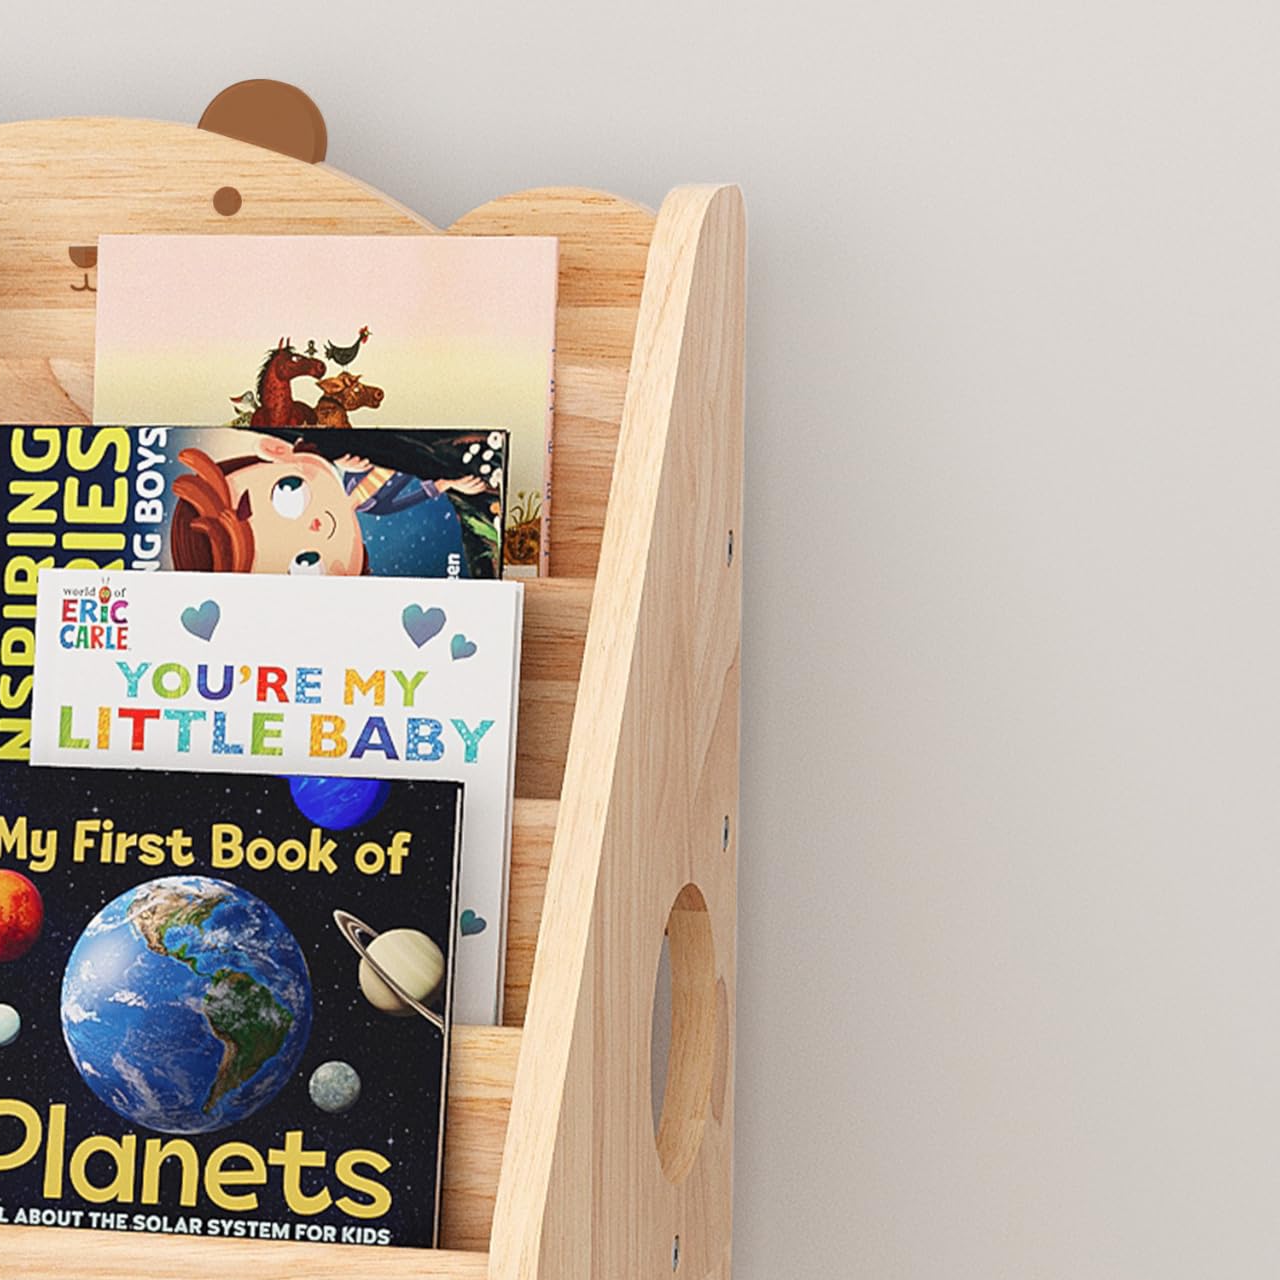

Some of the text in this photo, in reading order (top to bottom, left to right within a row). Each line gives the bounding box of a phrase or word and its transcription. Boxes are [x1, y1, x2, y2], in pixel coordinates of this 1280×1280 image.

[62, 427, 131, 569] IES
[134, 427, 168, 523] BOYS
[63, 587, 127, 598] world of
[59, 625, 128, 650] CARLE
[116, 661, 429, 707] YOU'RE MY
[58, 705, 496, 764] LITTLE BABY
[72, 818, 195, 867] First
[211, 823, 338, 874] Book
[354, 830, 412, 875] of
[14, 1207, 84, 1227] ABOUT
[88, 1211, 128, 1230] THE
[132, 1214, 202, 1235] SOLAR
[207, 1218, 290, 1240] SYSTEM
[295, 1223, 337, 1242] FOR
[341, 1226, 391, 1245] KIDS
